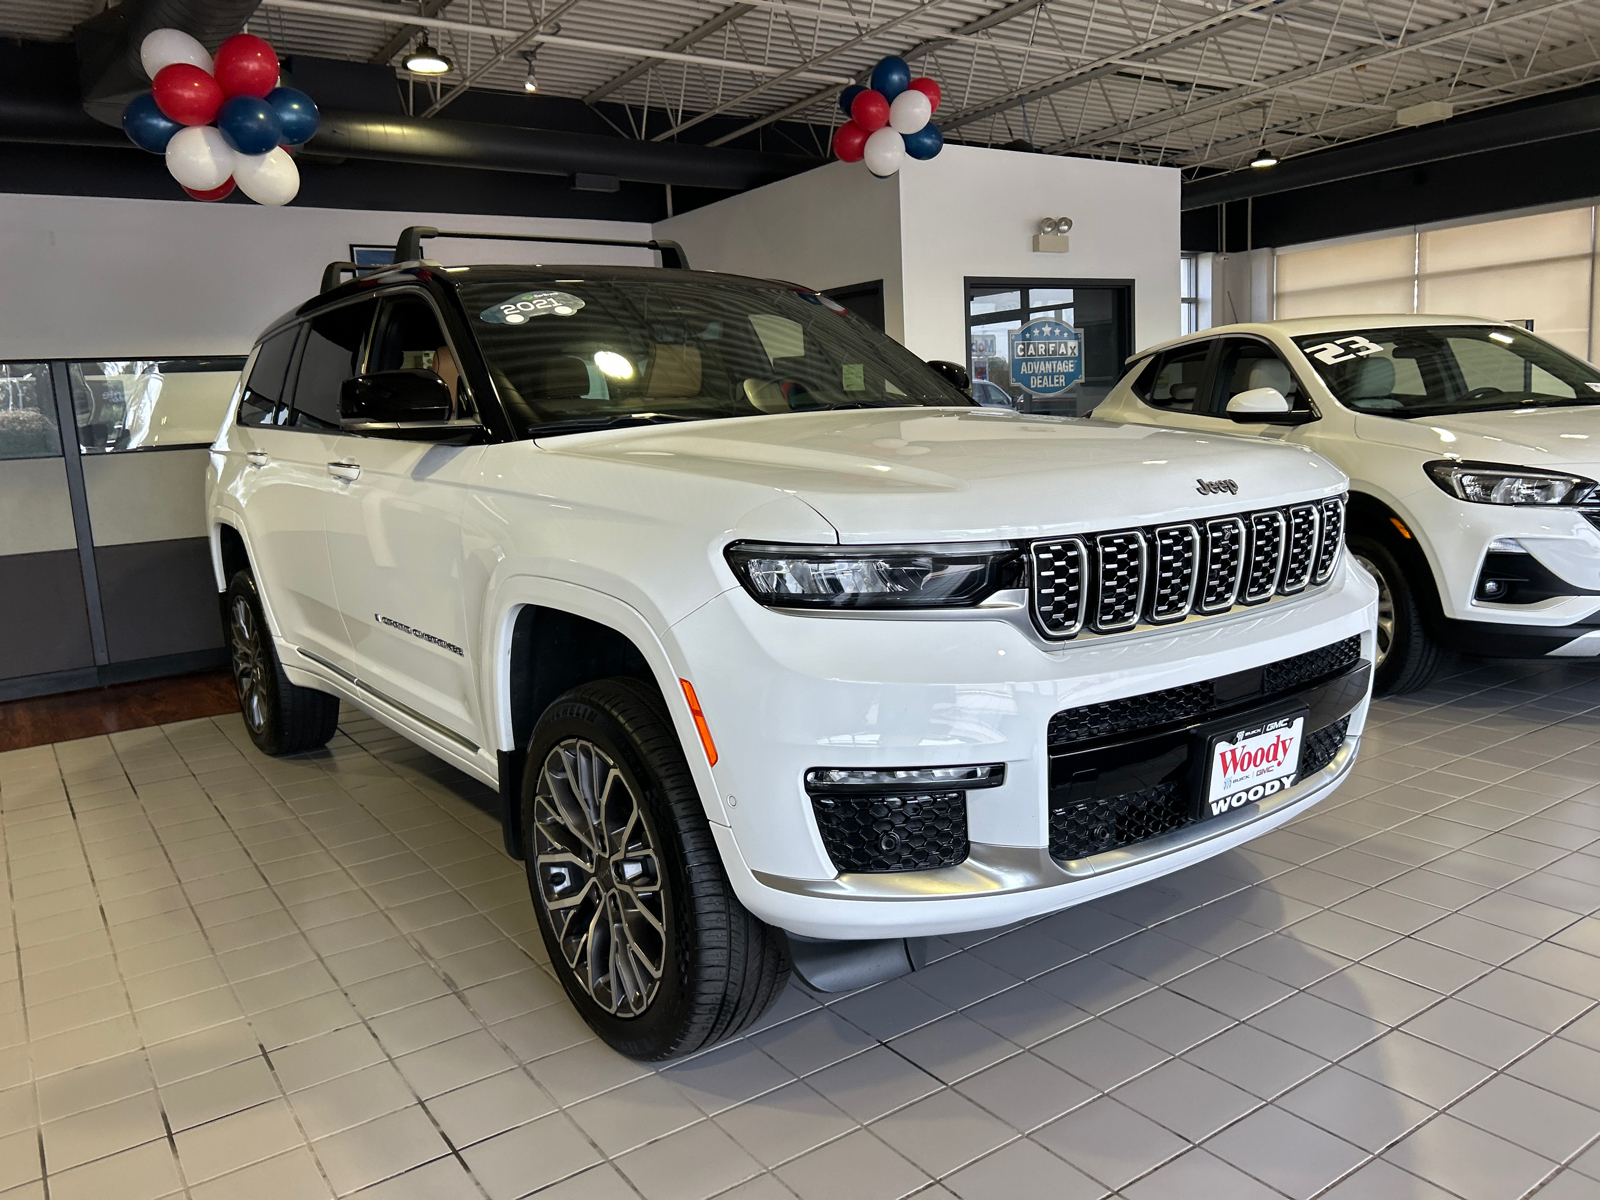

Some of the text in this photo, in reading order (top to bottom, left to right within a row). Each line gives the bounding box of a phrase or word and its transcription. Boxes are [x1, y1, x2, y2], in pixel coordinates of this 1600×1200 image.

[500, 297, 563, 315] 2021
[1016, 342, 1077, 357] CARFAX
[1303, 335, 1384, 365] 23
[1020, 360, 1074, 375] ADVANTAGE
[1030, 375, 1066, 389] DEALER
[1196, 478, 1239, 496] Jeep
[1265, 717, 1290, 732] GMC
[1219, 733, 1294, 778] Woody
[1232, 765, 1275, 784] BUICK GMC
[1210, 773, 1297, 817] WOODY
